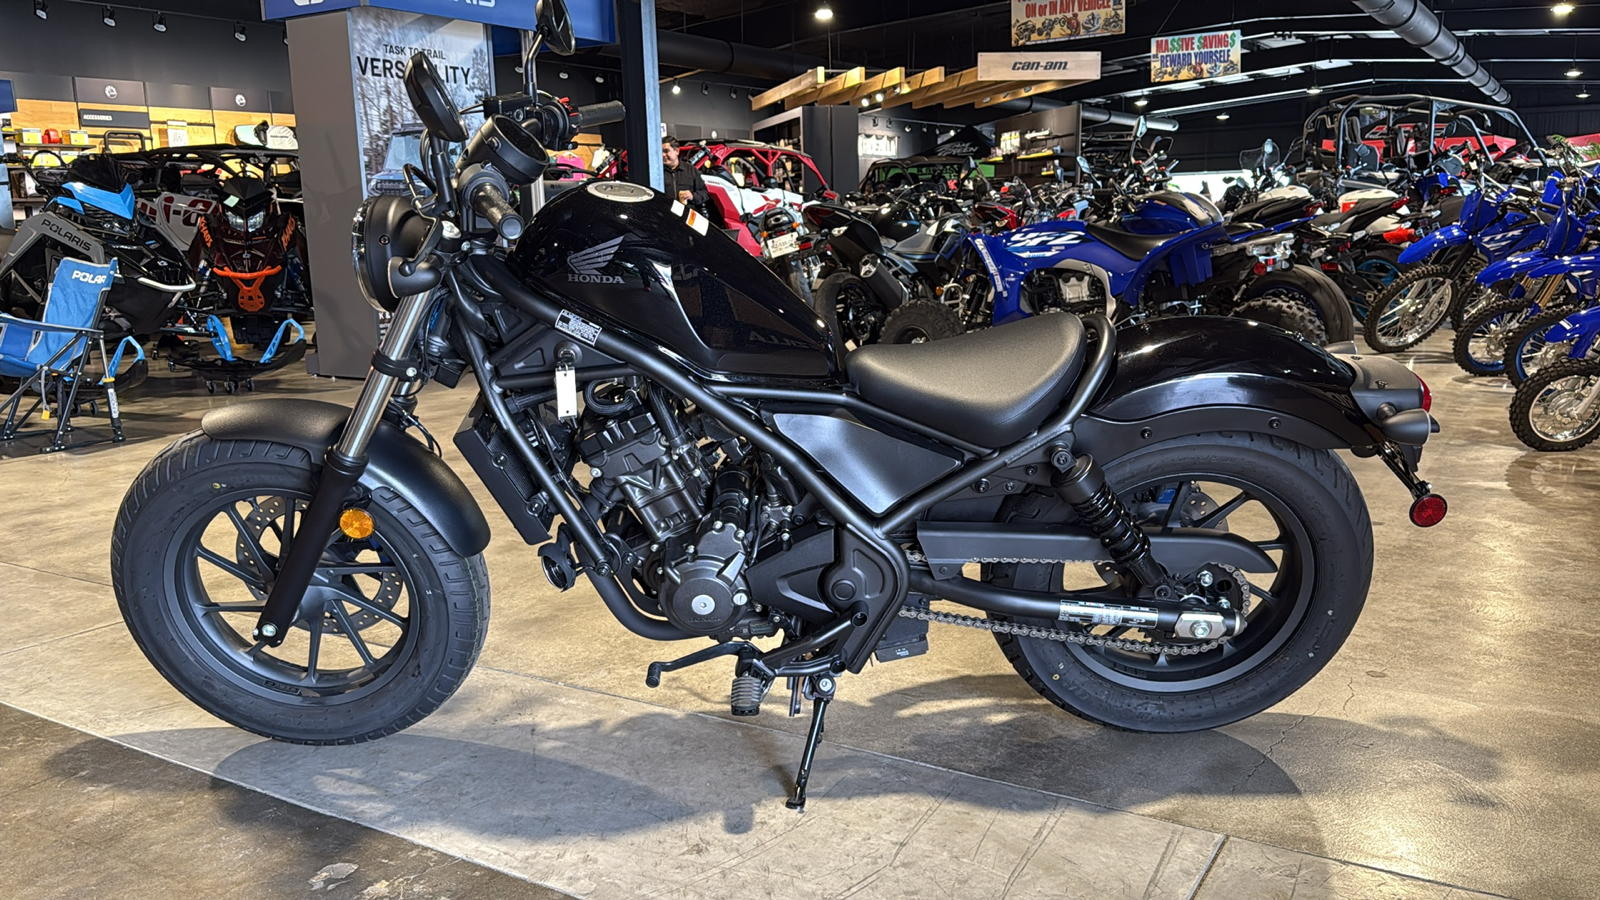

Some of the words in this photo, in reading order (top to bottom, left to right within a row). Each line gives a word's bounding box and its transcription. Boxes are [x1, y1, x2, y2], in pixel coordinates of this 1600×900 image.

[1025, 3, 1037, 19] ON
[1038, 4, 1048, 17] or
[1049, 0, 1058, 15] IN
[1059, 0, 1076, 14] ANY
[1077, 0, 1111, 12] VEHICLE
[383, 44, 406, 55] TASK
[1160, 51, 1192, 68] REWARD
[1193, 49, 1231, 65] YOURSELF
[356, 56, 471, 86] VERSITY
[1011, 61, 1069, 71] can-am
[41, 218, 92, 252] POLARIS
[200, 216, 214, 248] KHAOS
[567, 273, 626, 284] HONDA
